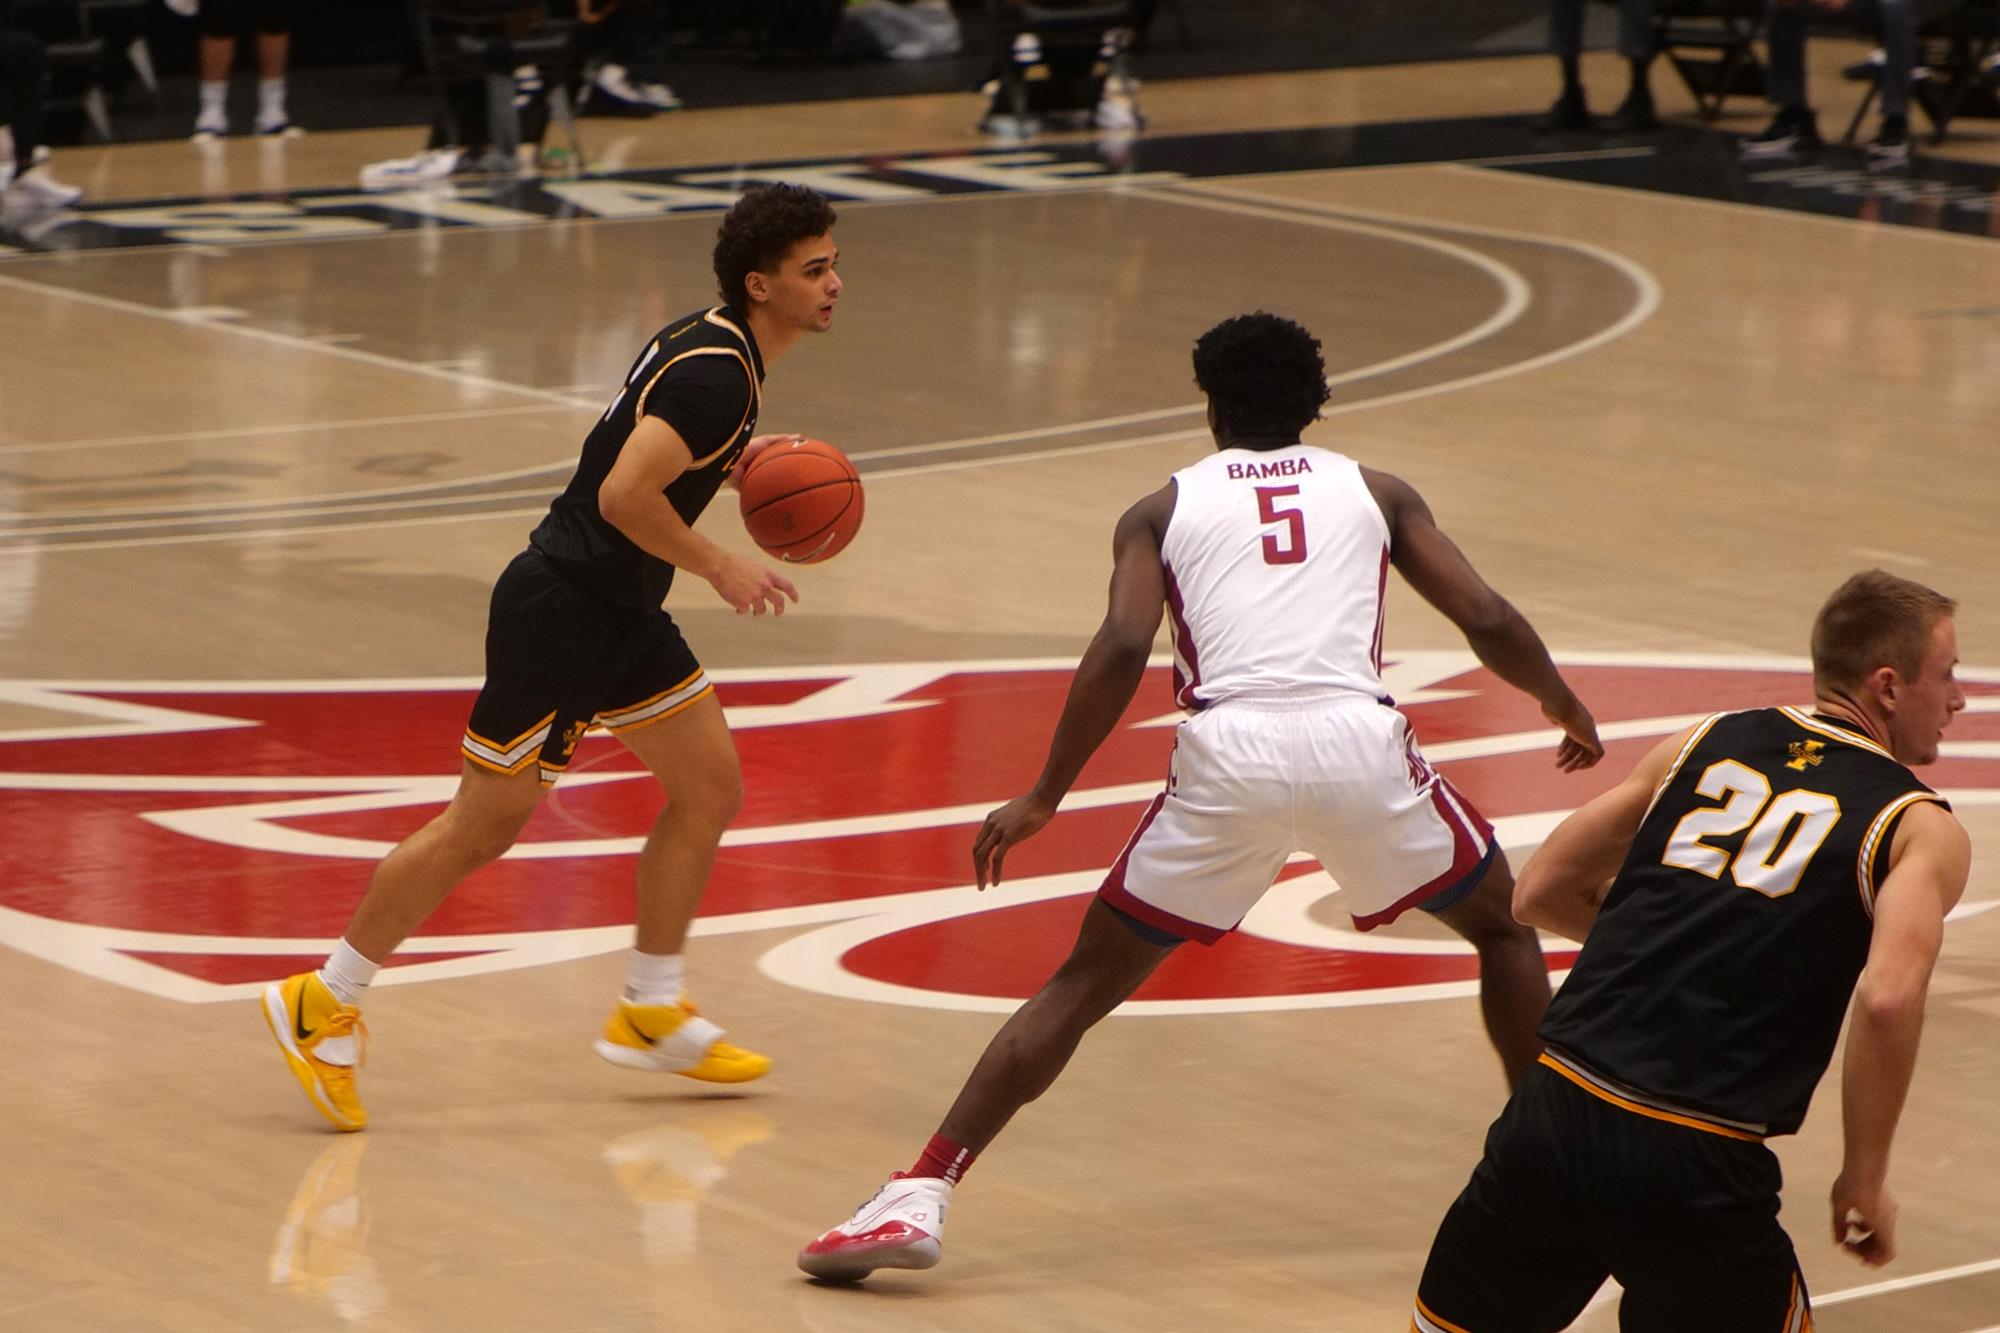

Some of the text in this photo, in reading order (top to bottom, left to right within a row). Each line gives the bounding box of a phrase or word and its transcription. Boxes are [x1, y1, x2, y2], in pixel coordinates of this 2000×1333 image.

[84, 152, 1188, 243] STATE
[1227, 457, 1312, 479] BAMBA
[1254, 484, 1307, 565] 5
[1661, 758, 1842, 899] 20
